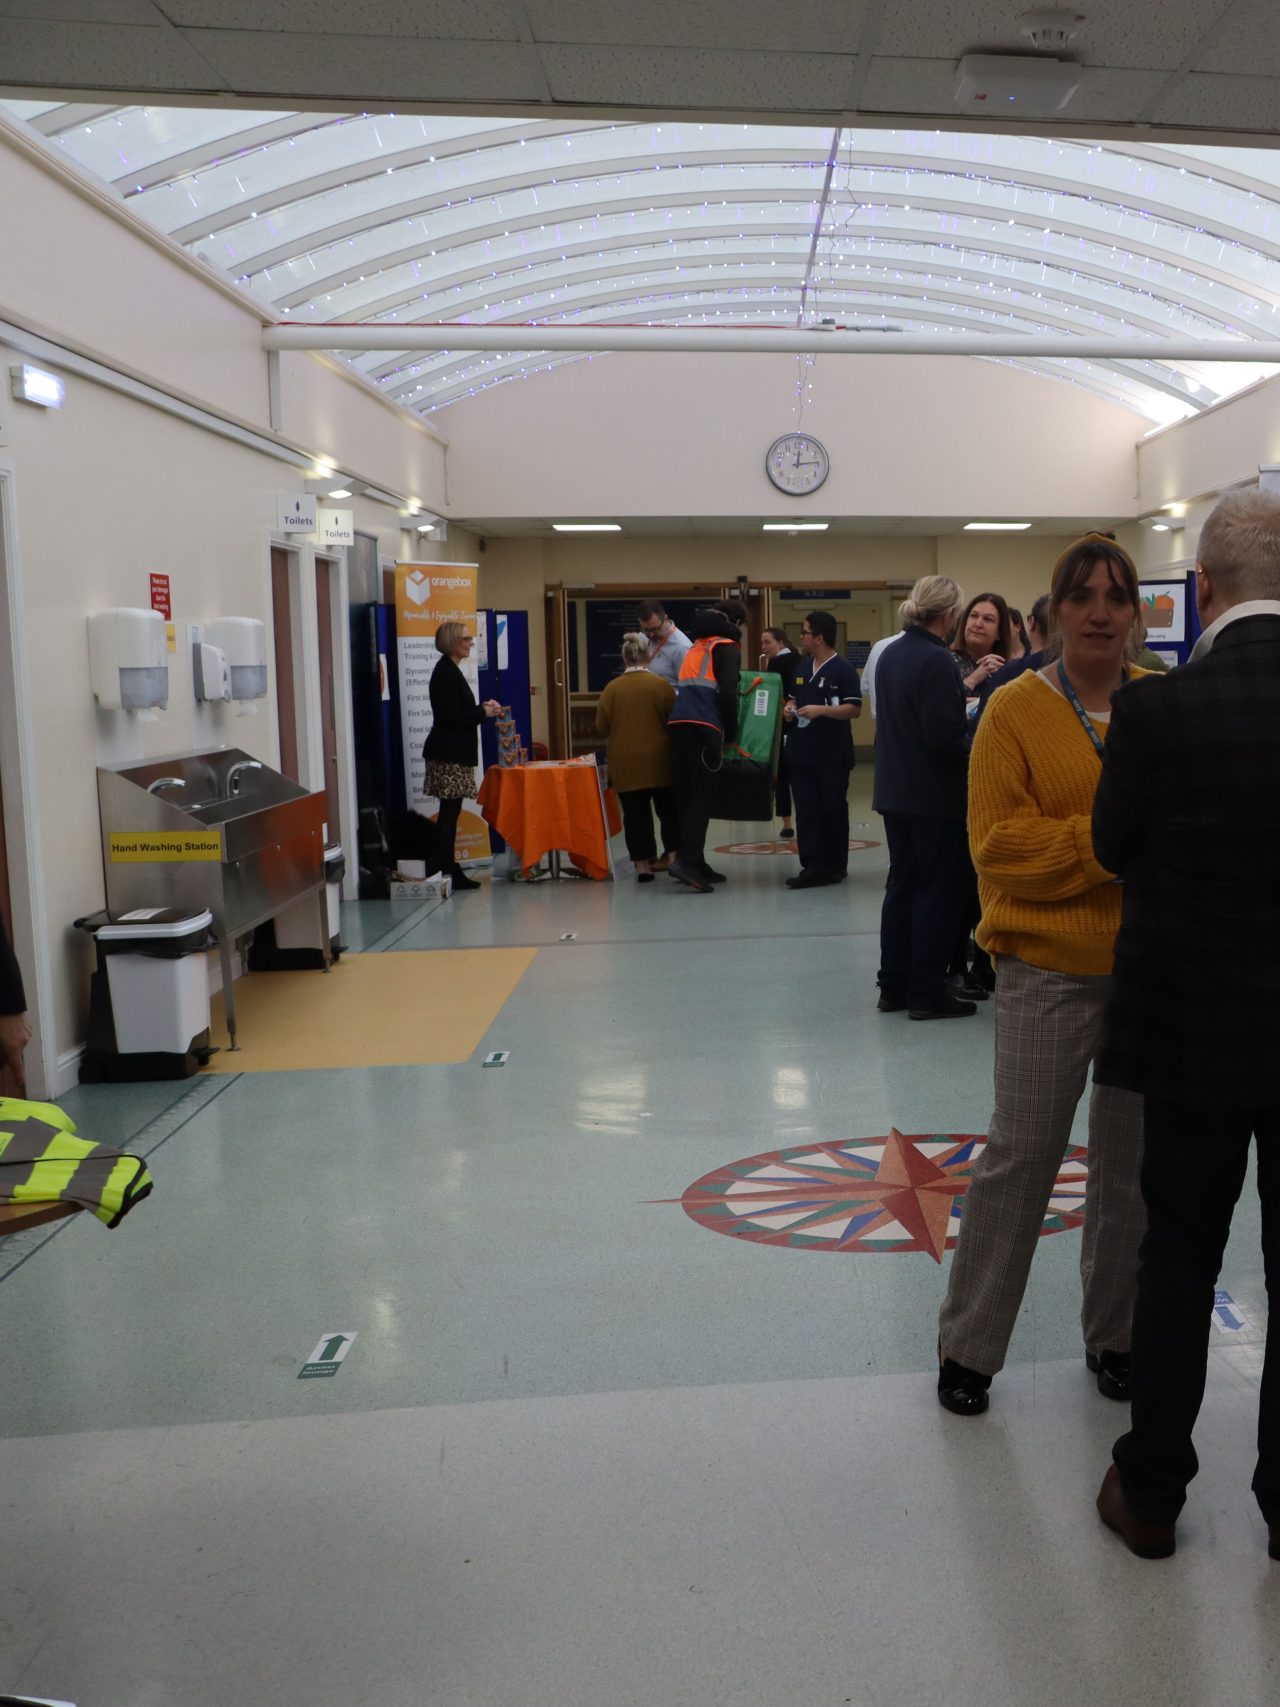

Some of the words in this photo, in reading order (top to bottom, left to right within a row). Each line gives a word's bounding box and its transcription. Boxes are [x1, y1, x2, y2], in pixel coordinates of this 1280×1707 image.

[284, 516, 313, 526] Toilets
[325, 529, 350, 538] Toilets
[432, 576, 471, 589] orangebox
[112, 843, 137, 853] Hand
[139, 842, 182, 853] Washing
[184, 842, 219, 851] Station
